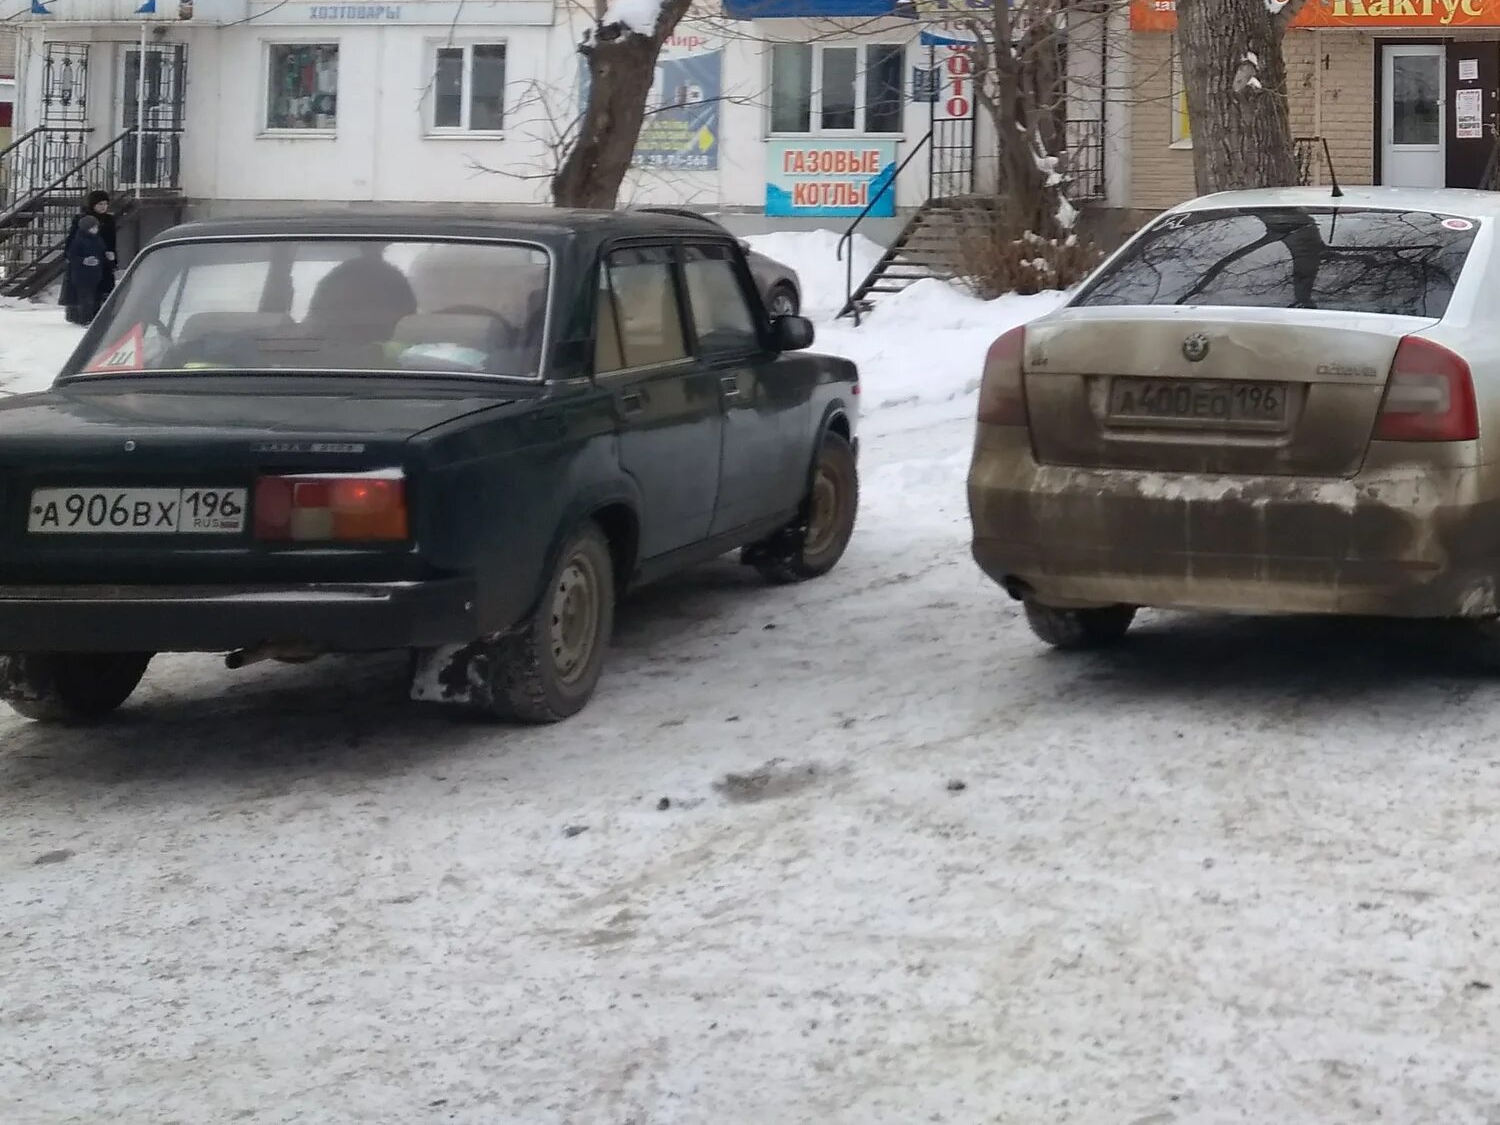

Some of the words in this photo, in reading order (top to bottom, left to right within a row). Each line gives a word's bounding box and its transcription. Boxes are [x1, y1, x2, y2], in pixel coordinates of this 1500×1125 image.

[783, 149, 880, 174] ГАЗОВЫЕ
[793, 182, 868, 206] КОТЛЫ
[40, 494, 175, 527] А906ВХ
[186, 491, 231, 518] 196
